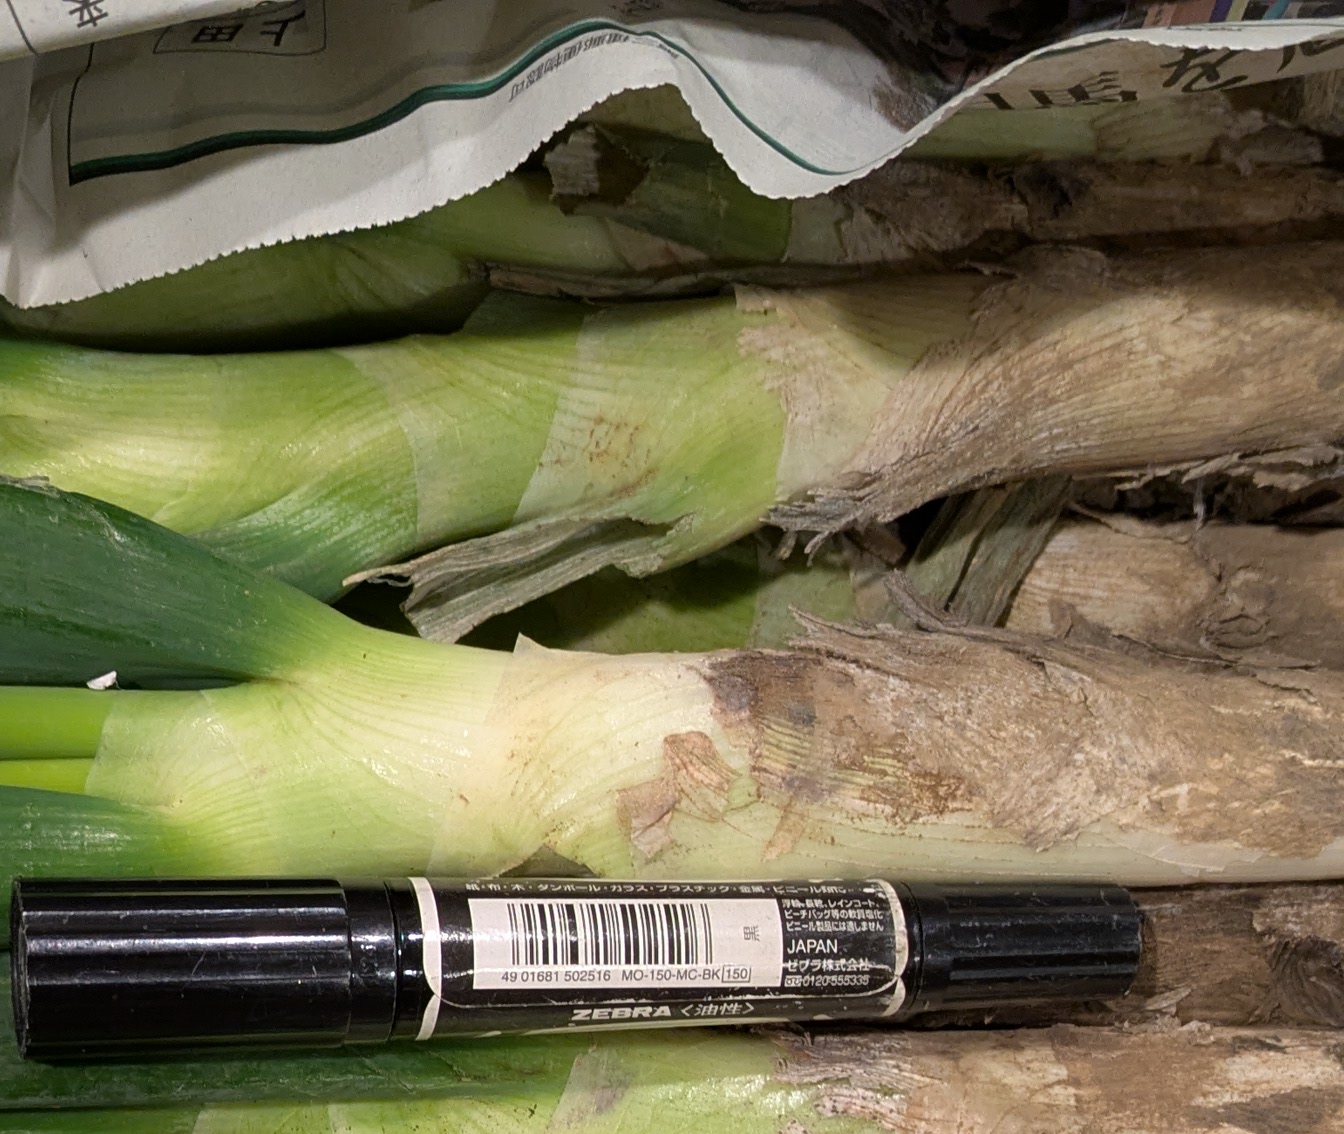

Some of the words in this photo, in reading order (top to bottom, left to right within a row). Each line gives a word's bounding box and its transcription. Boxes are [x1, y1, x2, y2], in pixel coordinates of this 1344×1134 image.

[787, 939, 838, 954] JAPAN
[787, 958, 870, 973] ゼブラ株式会社
[501, 970, 517, 982] 49
[520, 970, 559, 982] 01681
[564, 969, 611, 982] 502516
[621, 968, 721, 982] MO-150-MC-BK
[726, 967, 747, 980] 150
[572, 1005, 672, 1021] ZEBRA
